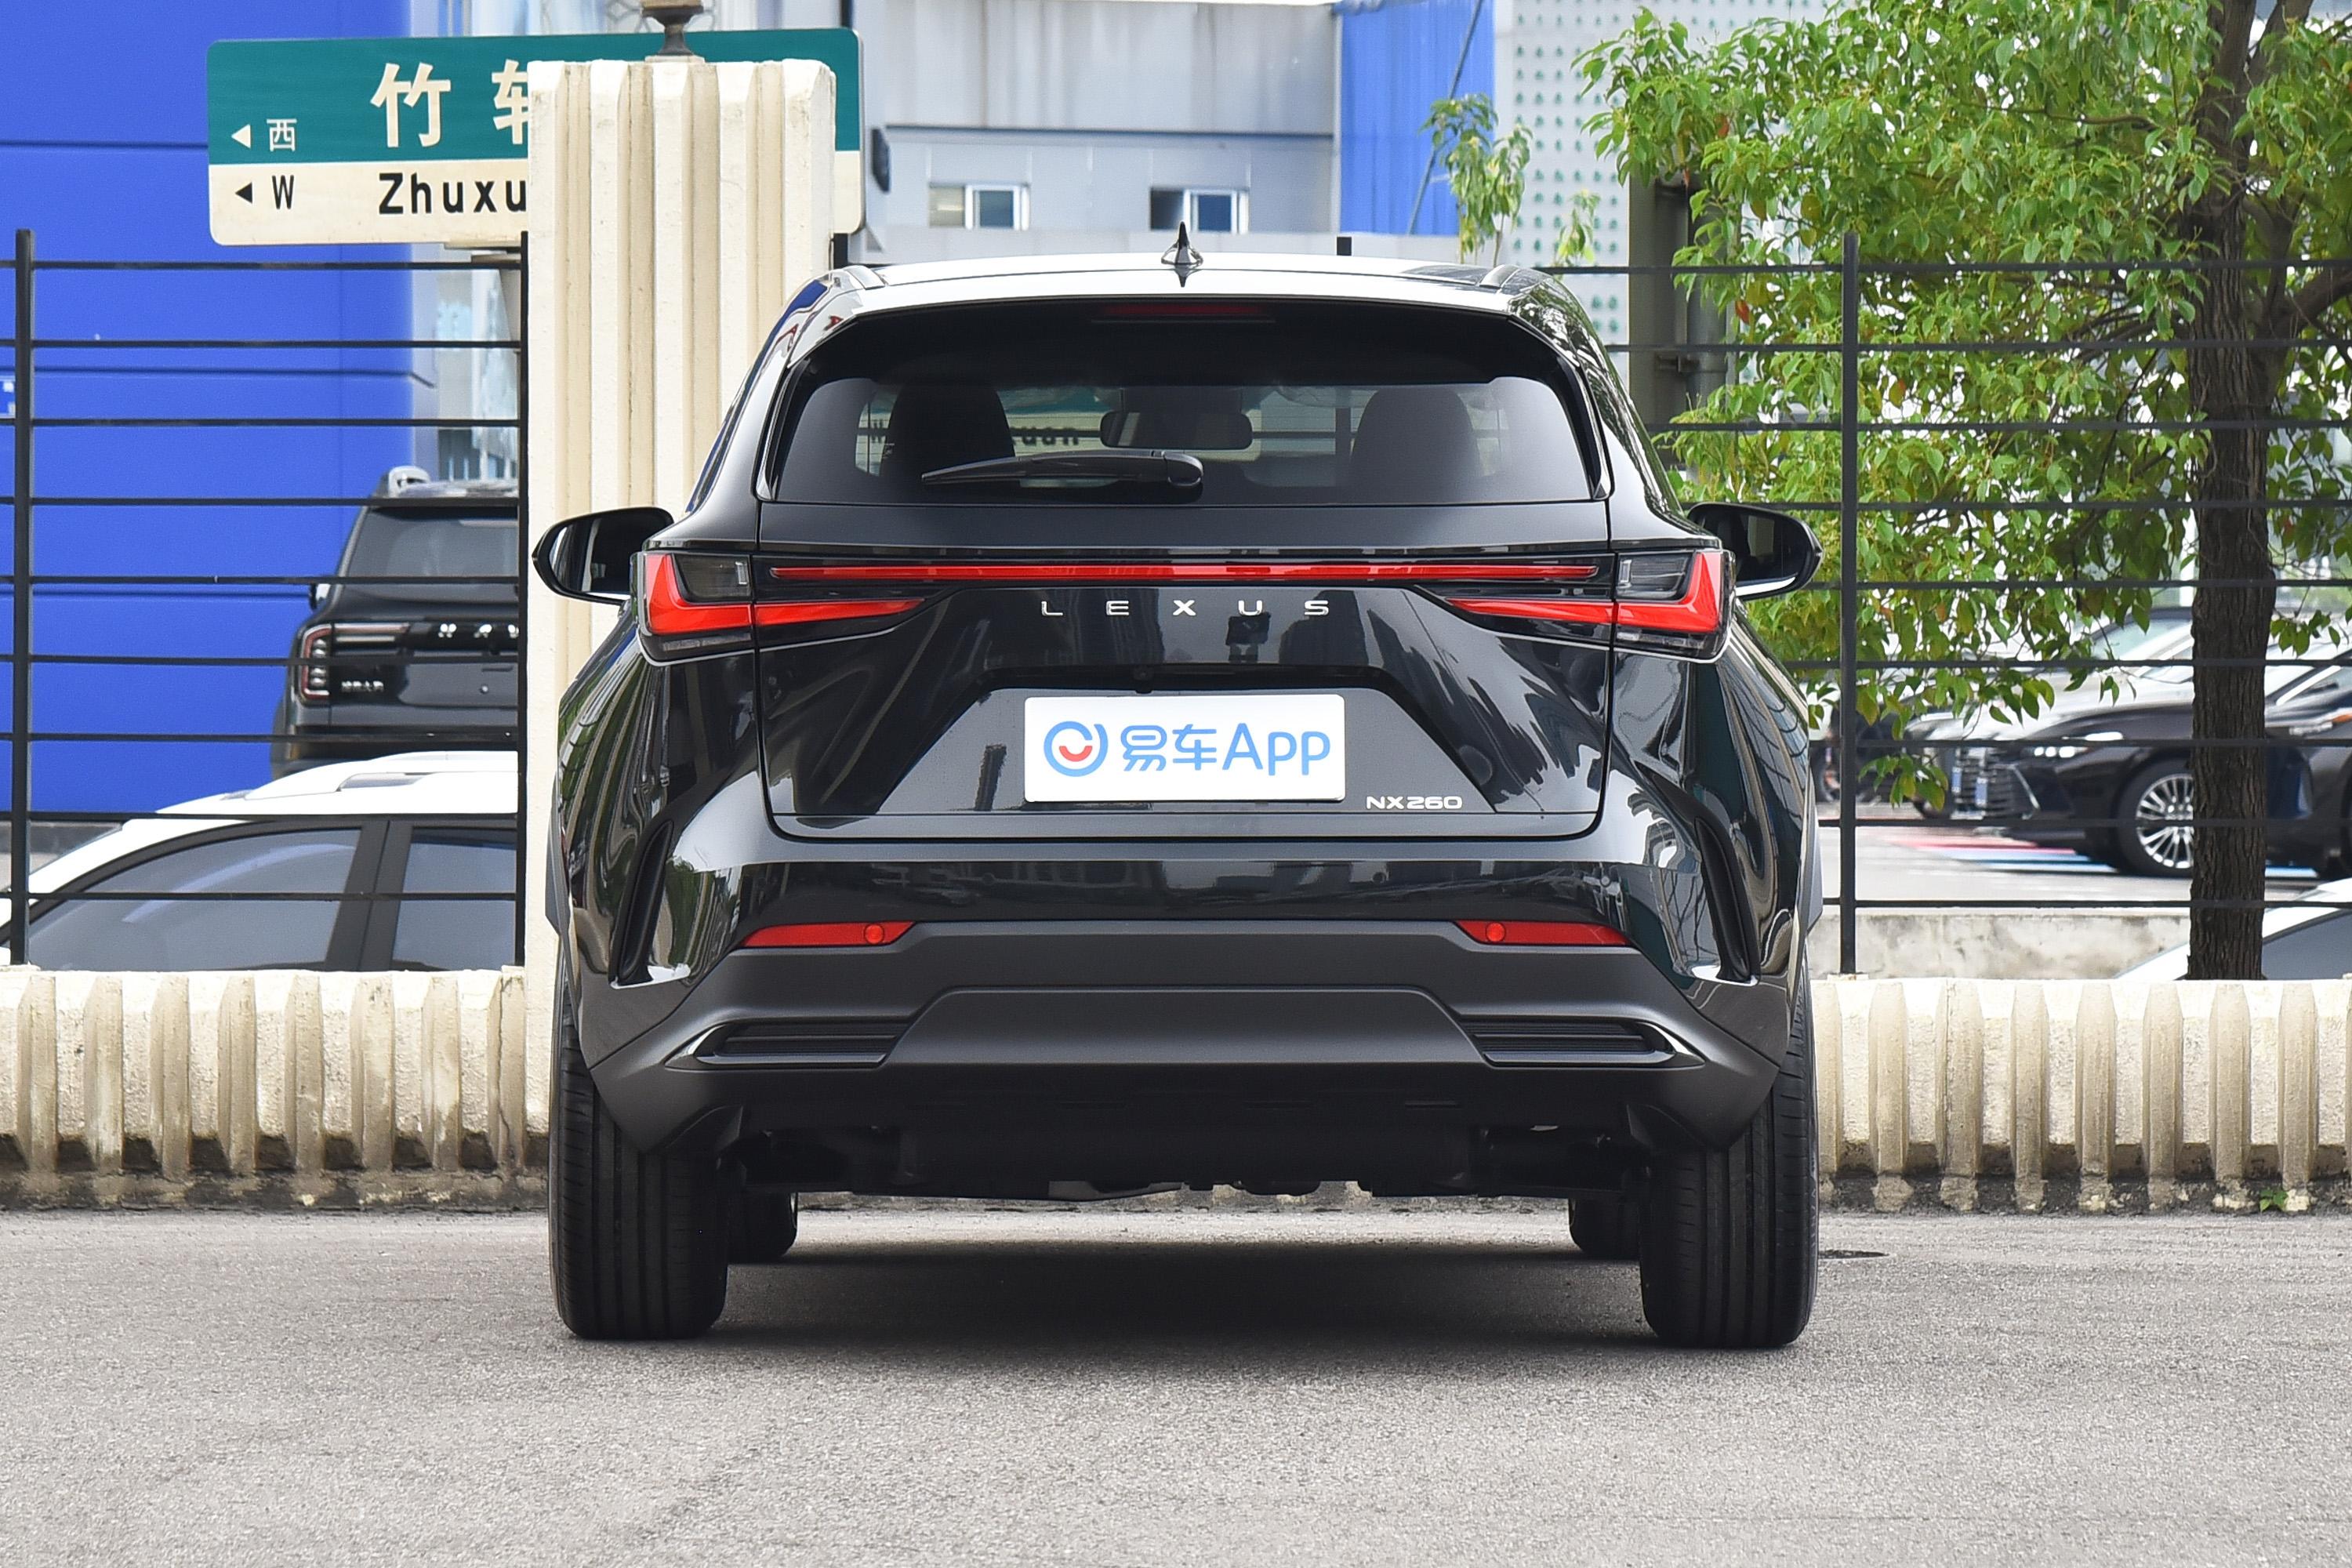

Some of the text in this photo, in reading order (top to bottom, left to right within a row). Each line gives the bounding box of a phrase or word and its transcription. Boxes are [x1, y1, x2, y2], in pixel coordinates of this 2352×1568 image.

[267, 118, 297, 152] 西
[271, 175, 295, 209] W
[379, 172, 527, 215] Zhuxu
[1041, 600, 1329, 616] LEXUS
[1120, 722, 1330, 776] 易车App
